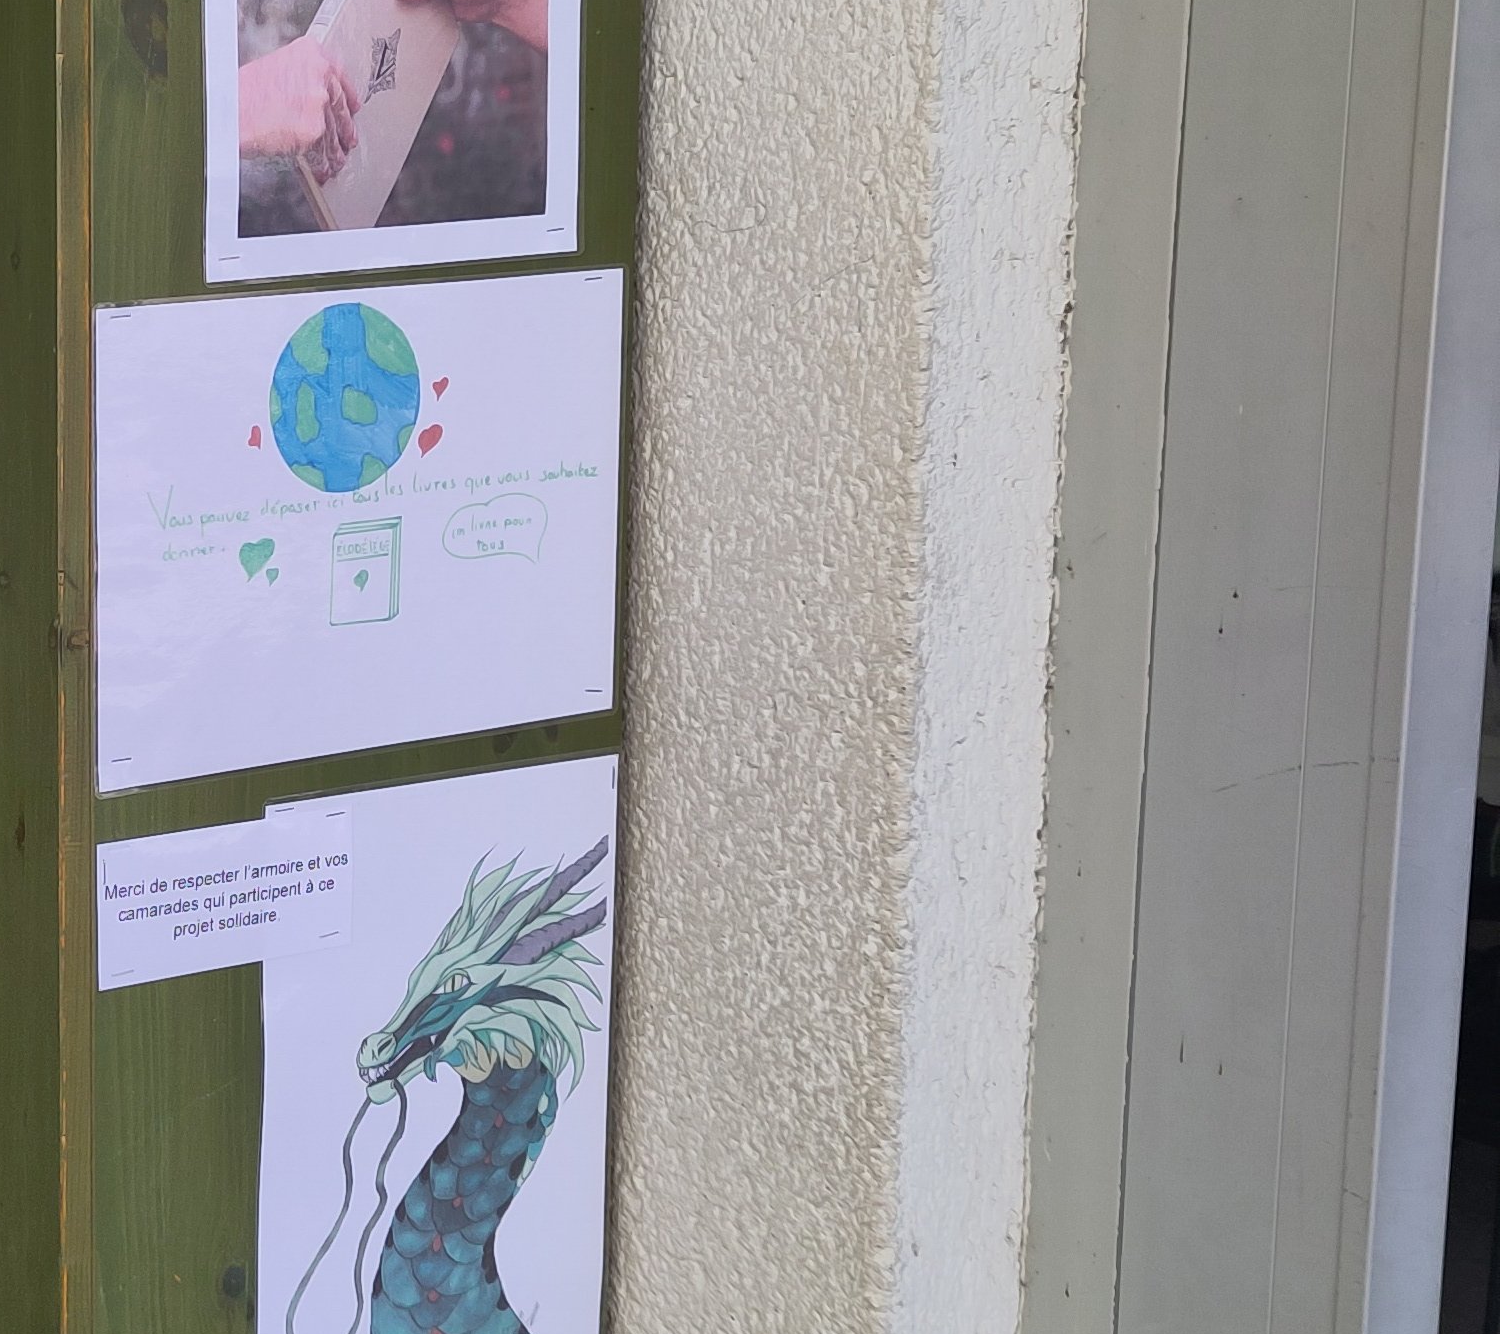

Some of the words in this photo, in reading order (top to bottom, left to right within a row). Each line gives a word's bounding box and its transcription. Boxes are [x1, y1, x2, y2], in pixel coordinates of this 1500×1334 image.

[147, 484, 193, 530] Vous
[199, 510, 250, 537] pouvez
[260, 499, 319, 519] déposer
[352, 489, 379, 503] tous
[385, 470, 403, 496] les
[412, 471, 456, 493] livres
[464, 477, 491, 495] que
[498, 470, 530, 485] vous
[539, 461, 599, 482] souhaitez
[104, 881, 145, 900] Merci
[149, 877, 168, 894] de
[172, 868, 239, 892] respecter
[244, 860, 304, 881] l'armoire
[307, 855, 321, 870] et
[325, 853, 348, 867] vos
[118, 897, 199, 922] camarades
[203, 894, 224, 913] qui
[229, 881, 301, 908] participent
[305, 878, 314, 893] à
[318, 878, 335, 892] ce
[173, 918, 214, 940] projet
